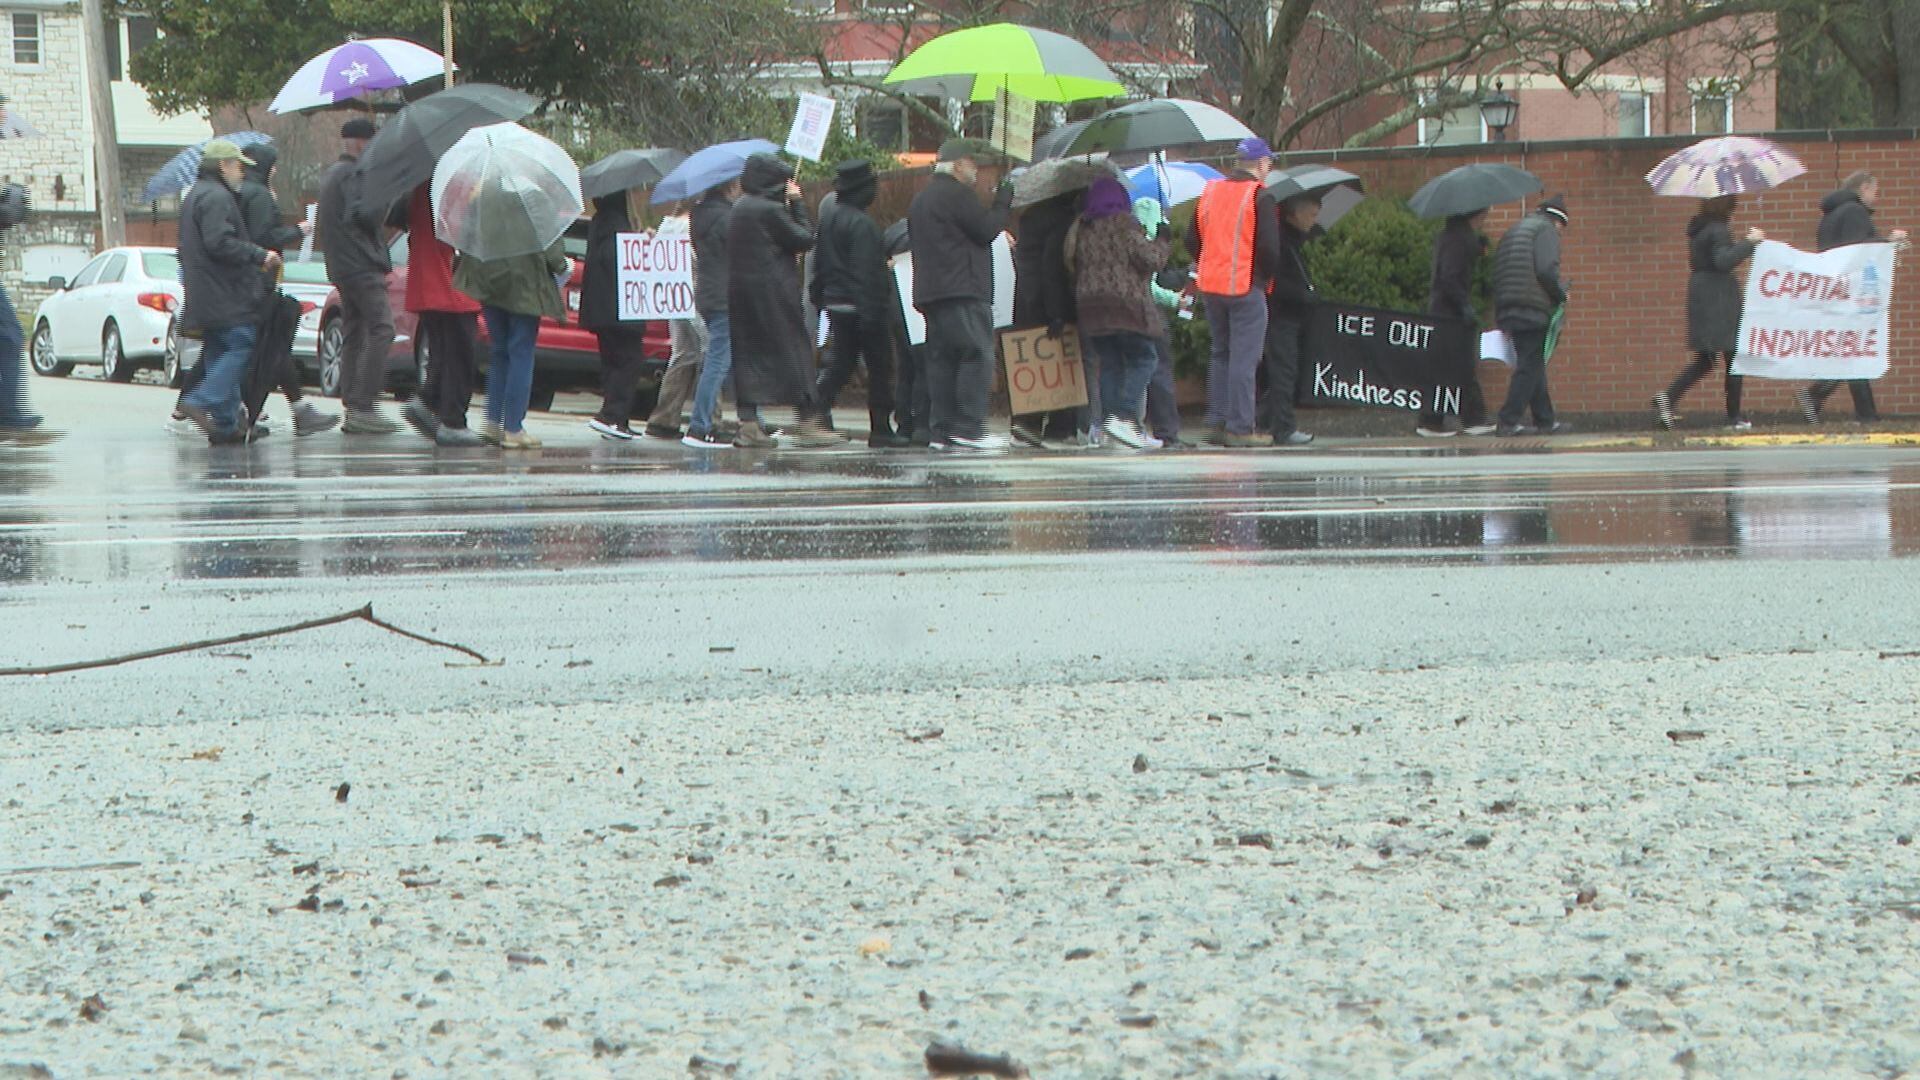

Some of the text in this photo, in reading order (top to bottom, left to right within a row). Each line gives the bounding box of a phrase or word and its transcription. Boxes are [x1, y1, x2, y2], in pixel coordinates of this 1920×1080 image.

[623, 238, 690, 272] ICE OUT
[624, 280, 694, 314] FOR GOOD
[1759, 269, 1850, 300] CAPITAL
[1011, 330, 1077, 364] ICE
[1337, 313, 1435, 349] ICE OUT
[1748, 326, 1879, 359] INDIVISIBLE
[1013, 359, 1077, 393] OUT
[1313, 362, 1461, 416] Kindness IN
